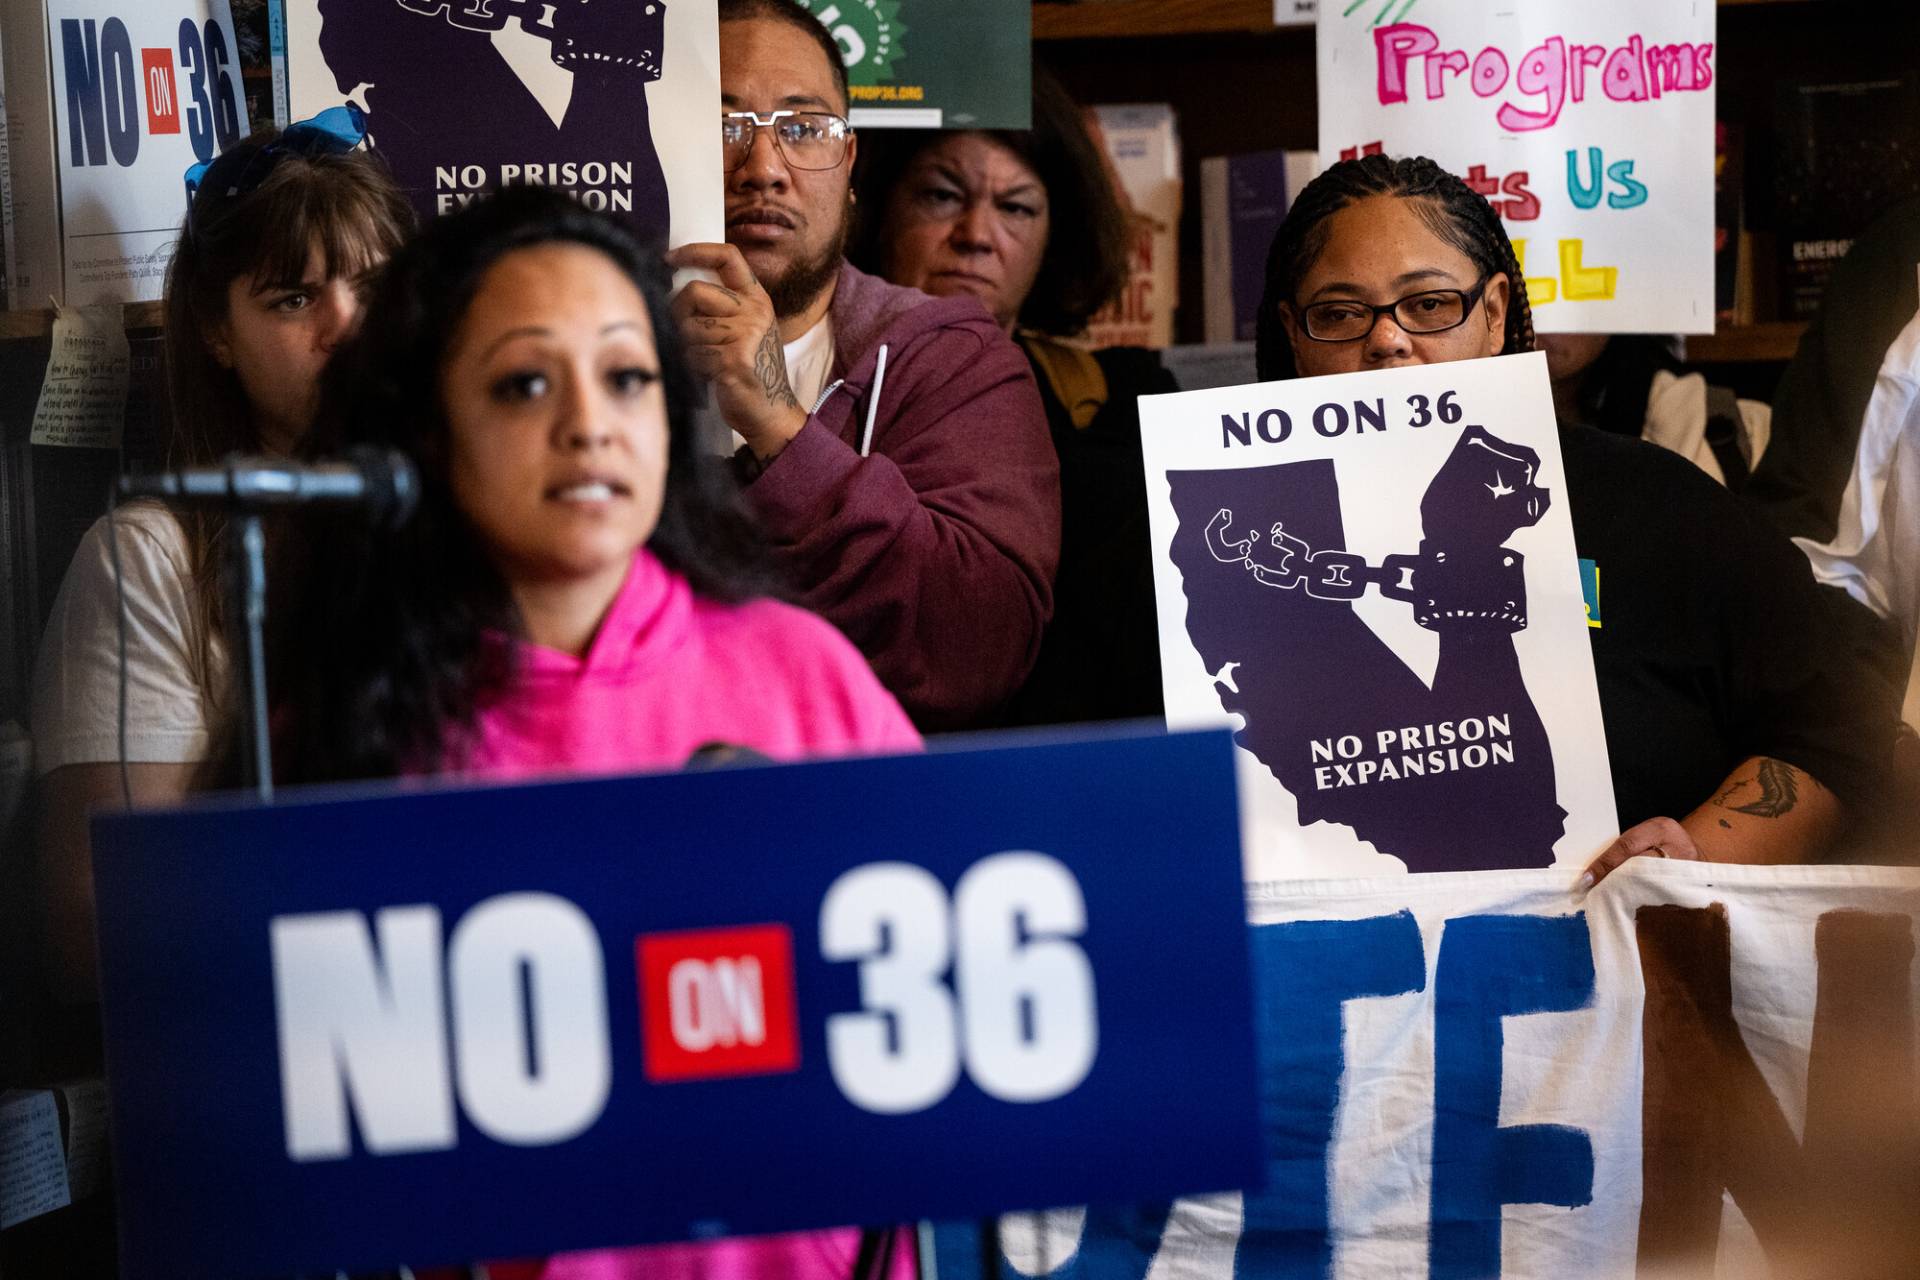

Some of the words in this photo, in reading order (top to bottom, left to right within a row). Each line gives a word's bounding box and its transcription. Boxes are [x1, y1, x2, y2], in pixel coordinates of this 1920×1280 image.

[60, 16, 139, 168] NO
[150, 66, 172, 116] ON
[178, 17, 241, 163] 36
[1374, 22, 1714, 132] Programs
[435, 164, 487, 190] NO
[501, 161, 632, 187] PRISON
[437, 189, 632, 216] EXION
[1566, 147, 1649, 210] Us
[1510, 237, 1618, 308] LL
[1793, 238, 1856, 260] ENERG
[1221, 408, 1293, 449] NO
[1312, 397, 1388, 436] ON
[1408, 390, 1463, 430] 36
[1310, 734, 1362, 764] NO
[1376, 713, 1513, 755] PRISON
[1314, 740, 1516, 791] EXPANSION
[270, 891, 613, 1163] NO
[666, 955, 766, 1054] ON
[818, 849, 1099, 1116] 36
